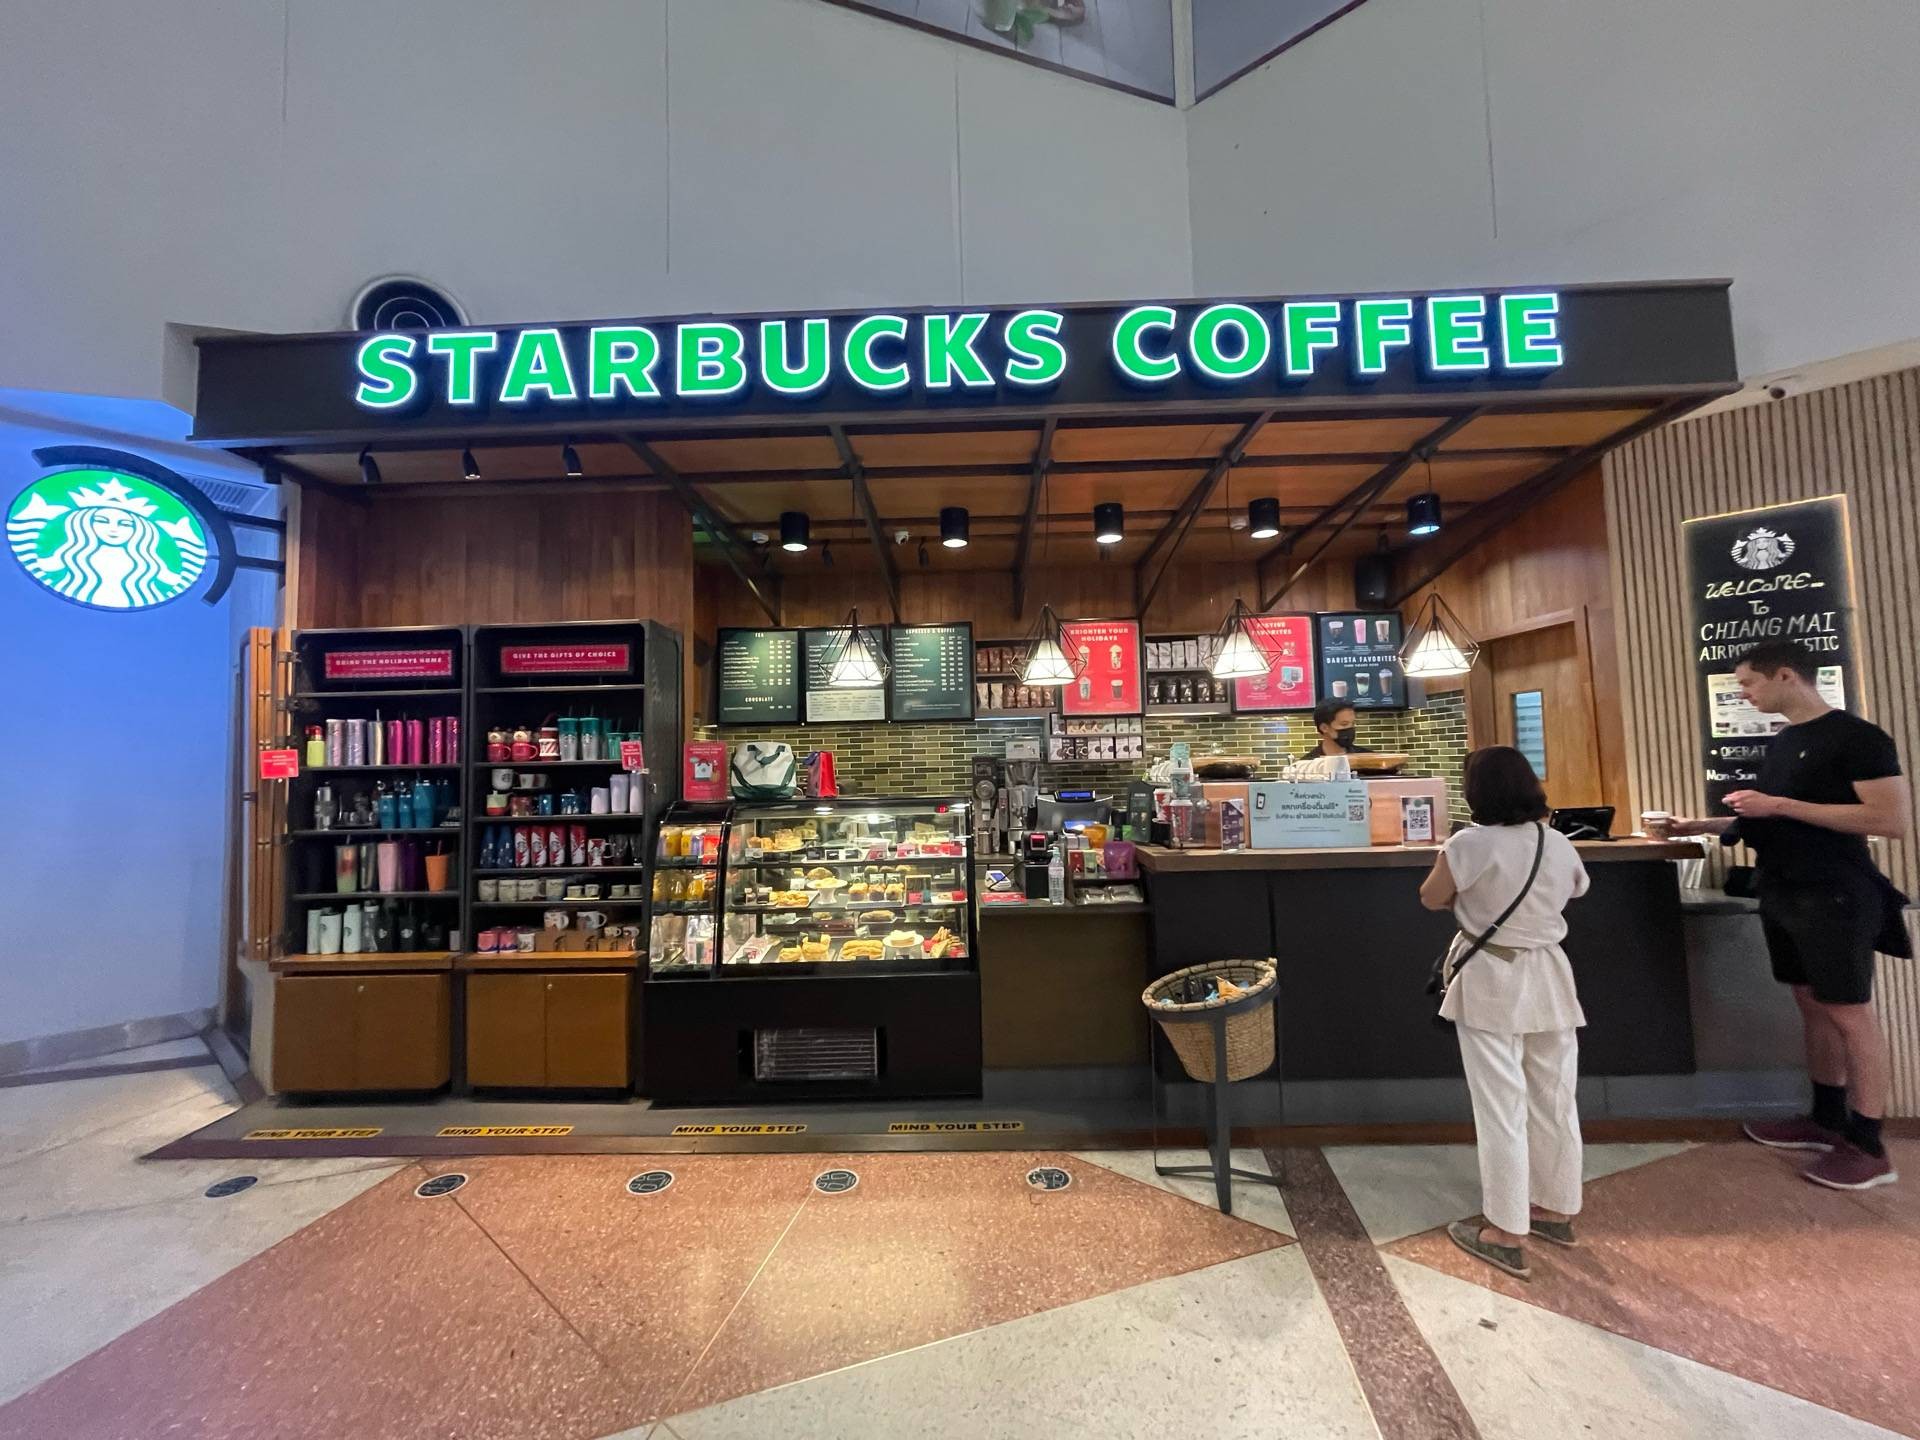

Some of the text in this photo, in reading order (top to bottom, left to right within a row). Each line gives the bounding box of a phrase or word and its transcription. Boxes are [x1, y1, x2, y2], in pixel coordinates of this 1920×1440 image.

[355, 292, 1564, 408] STARBUCKS COFFEE
[1700, 611, 1836, 641] CHIANG MAI
[1326, 655, 1397, 664] BARISTA FAVORITES
[1720, 745, 1769, 757] OPERAT
[1706, 769, 1757, 781] Mon-Sun
[485, 1127, 528, 1135] YOUR
[982, 1122, 1021, 1130] STEP
